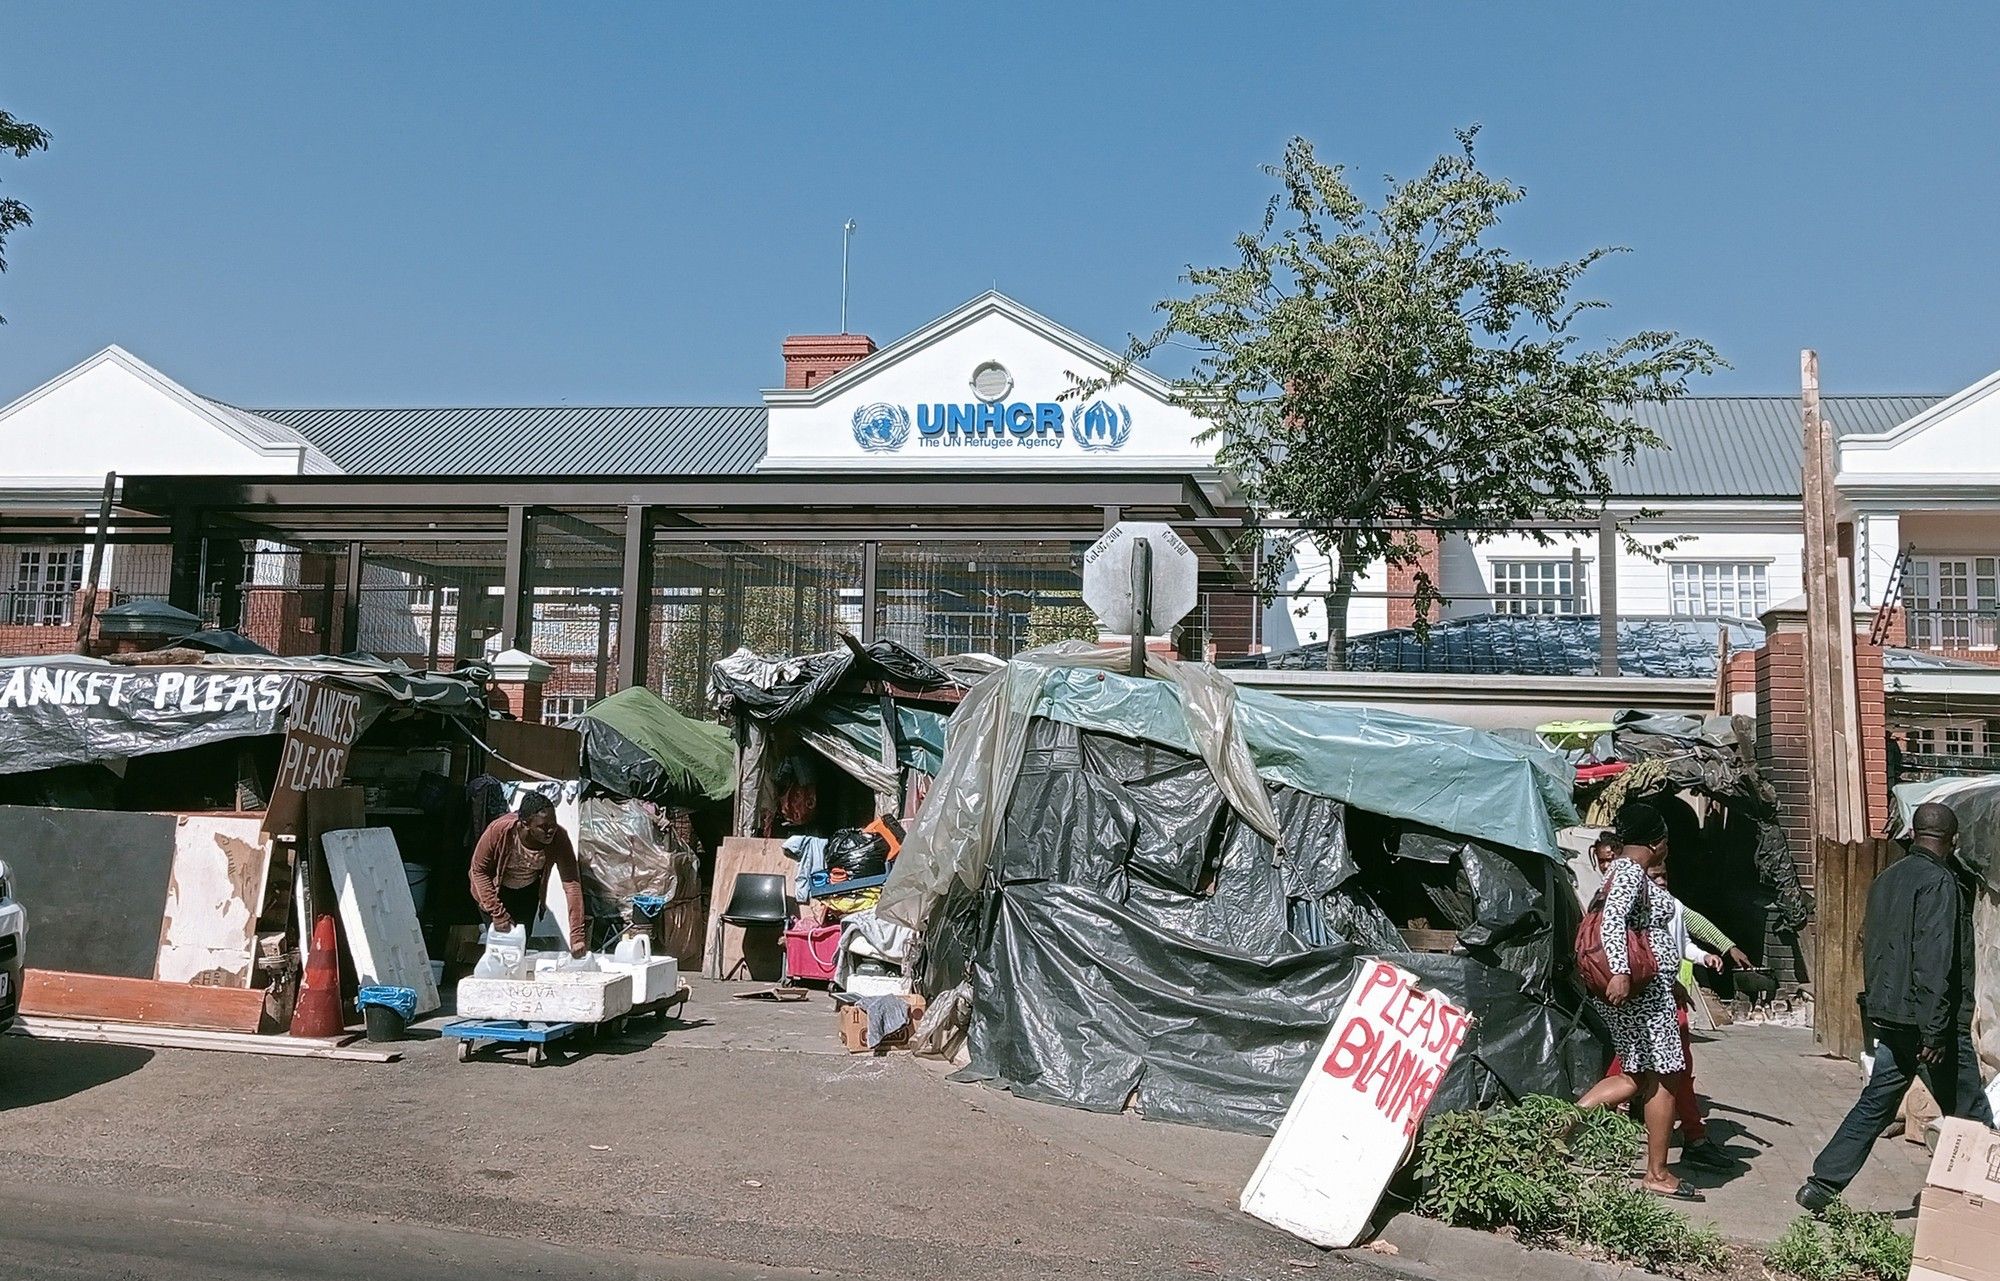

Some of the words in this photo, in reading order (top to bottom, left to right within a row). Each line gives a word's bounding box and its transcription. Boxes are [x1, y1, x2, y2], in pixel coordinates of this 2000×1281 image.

[917, 402, 1064, 436] UNHCR
[918, 437, 939, 448] The
[943, 437, 961, 448] UN
[964, 437, 1013, 449] Refugee
[1017, 437, 1062, 449] Agency
[290, 679, 361, 745] BLANKETS
[280, 738, 345, 791] PLEASE
[508, 986, 556, 998] NOVA
[1356, 964, 1470, 1066] PLEASE
